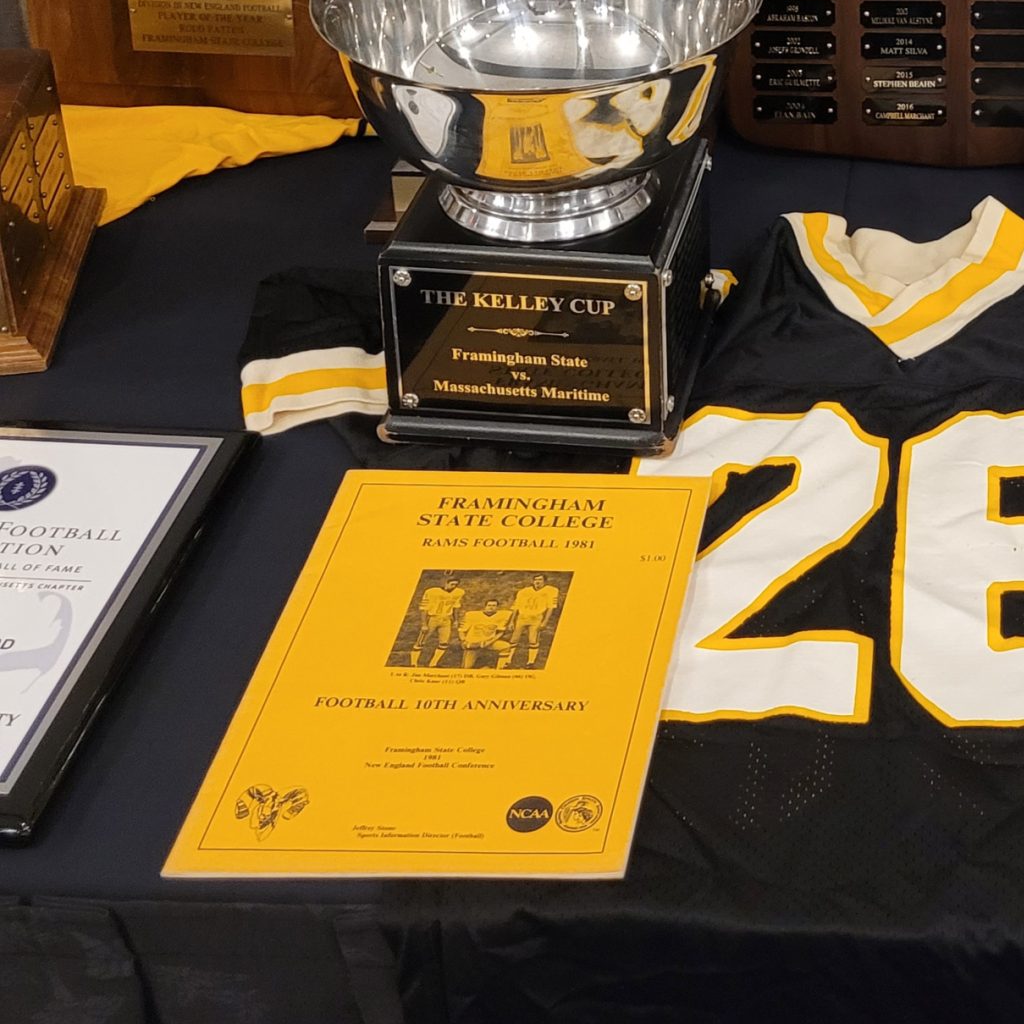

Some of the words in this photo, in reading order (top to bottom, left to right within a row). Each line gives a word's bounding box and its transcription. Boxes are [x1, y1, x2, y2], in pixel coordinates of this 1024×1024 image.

[876, 112, 903, 120] CAMPBELL
[905, 112, 935, 120] MARCHANT
[421, 289, 467, 306] THE
[473, 292, 564, 313] KELLEY
[570, 299, 615, 315] CUP
[451, 348, 546, 367] Framingham
[551, 354, 588, 368] State
[511, 371, 530, 381] vs.
[434, 380, 537, 397] Massachusetts
[541, 387, 609, 402] Maritime
[437, 497, 607, 512] FRAMINGHAM
[417, 514, 492, 527] STATE
[501, 514, 615, 529] COLLEGE
[421, 538, 469, 548] RAMS
[472, 539, 559, 549] FOOTBALL
[564, 539, 595, 549] 1981
[639, 554, 666, 562] $1.00
[45, 565, 83, 573] FAME
[38, 583, 85, 591] CHAPTER
[314, 696, 409, 710] FOOTBALL
[414, 698, 460, 710] 10TH
[463, 698, 590, 712] ANNIVERSARY
[384, 746, 430, 754] Framingham
[383, 762, 414, 770] England
[508, 808, 550, 820] NCAA
